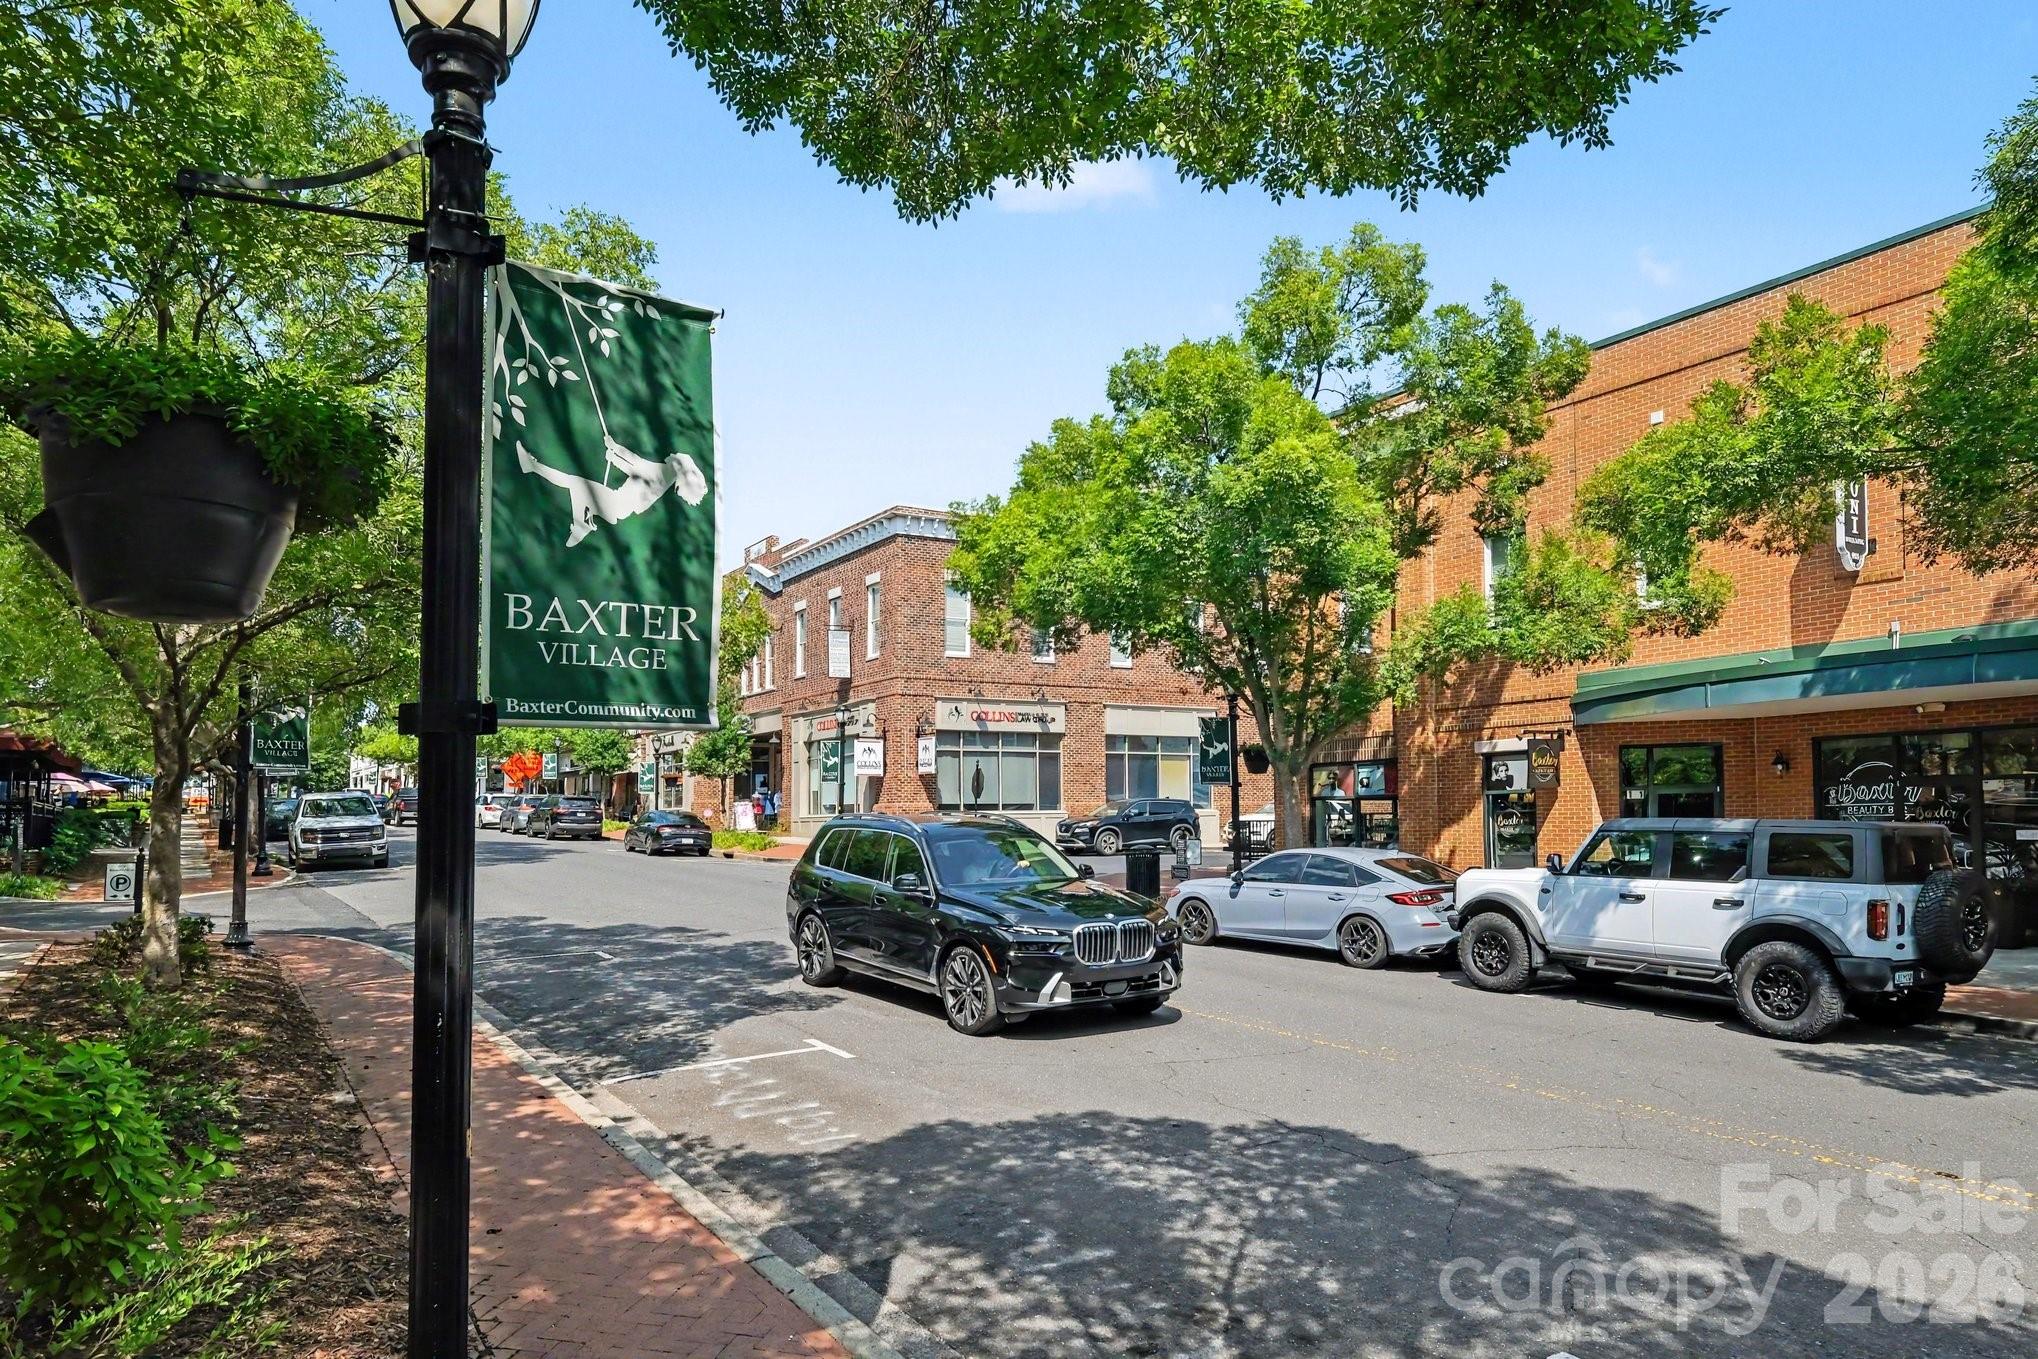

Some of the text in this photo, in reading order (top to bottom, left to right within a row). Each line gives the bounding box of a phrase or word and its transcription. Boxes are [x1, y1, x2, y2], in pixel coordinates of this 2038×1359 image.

[503, 592, 701, 642] BAXTER
[536, 641, 668, 671] VILLAGE
[505, 697, 697, 721] BaxterCommunity.com
[970, 710, 1016, 723] COLLINS
[256, 739, 305, 751] BAXTER
[1847, 805, 1884, 815] BEAUTY
[115, 877, 128, 889] P
